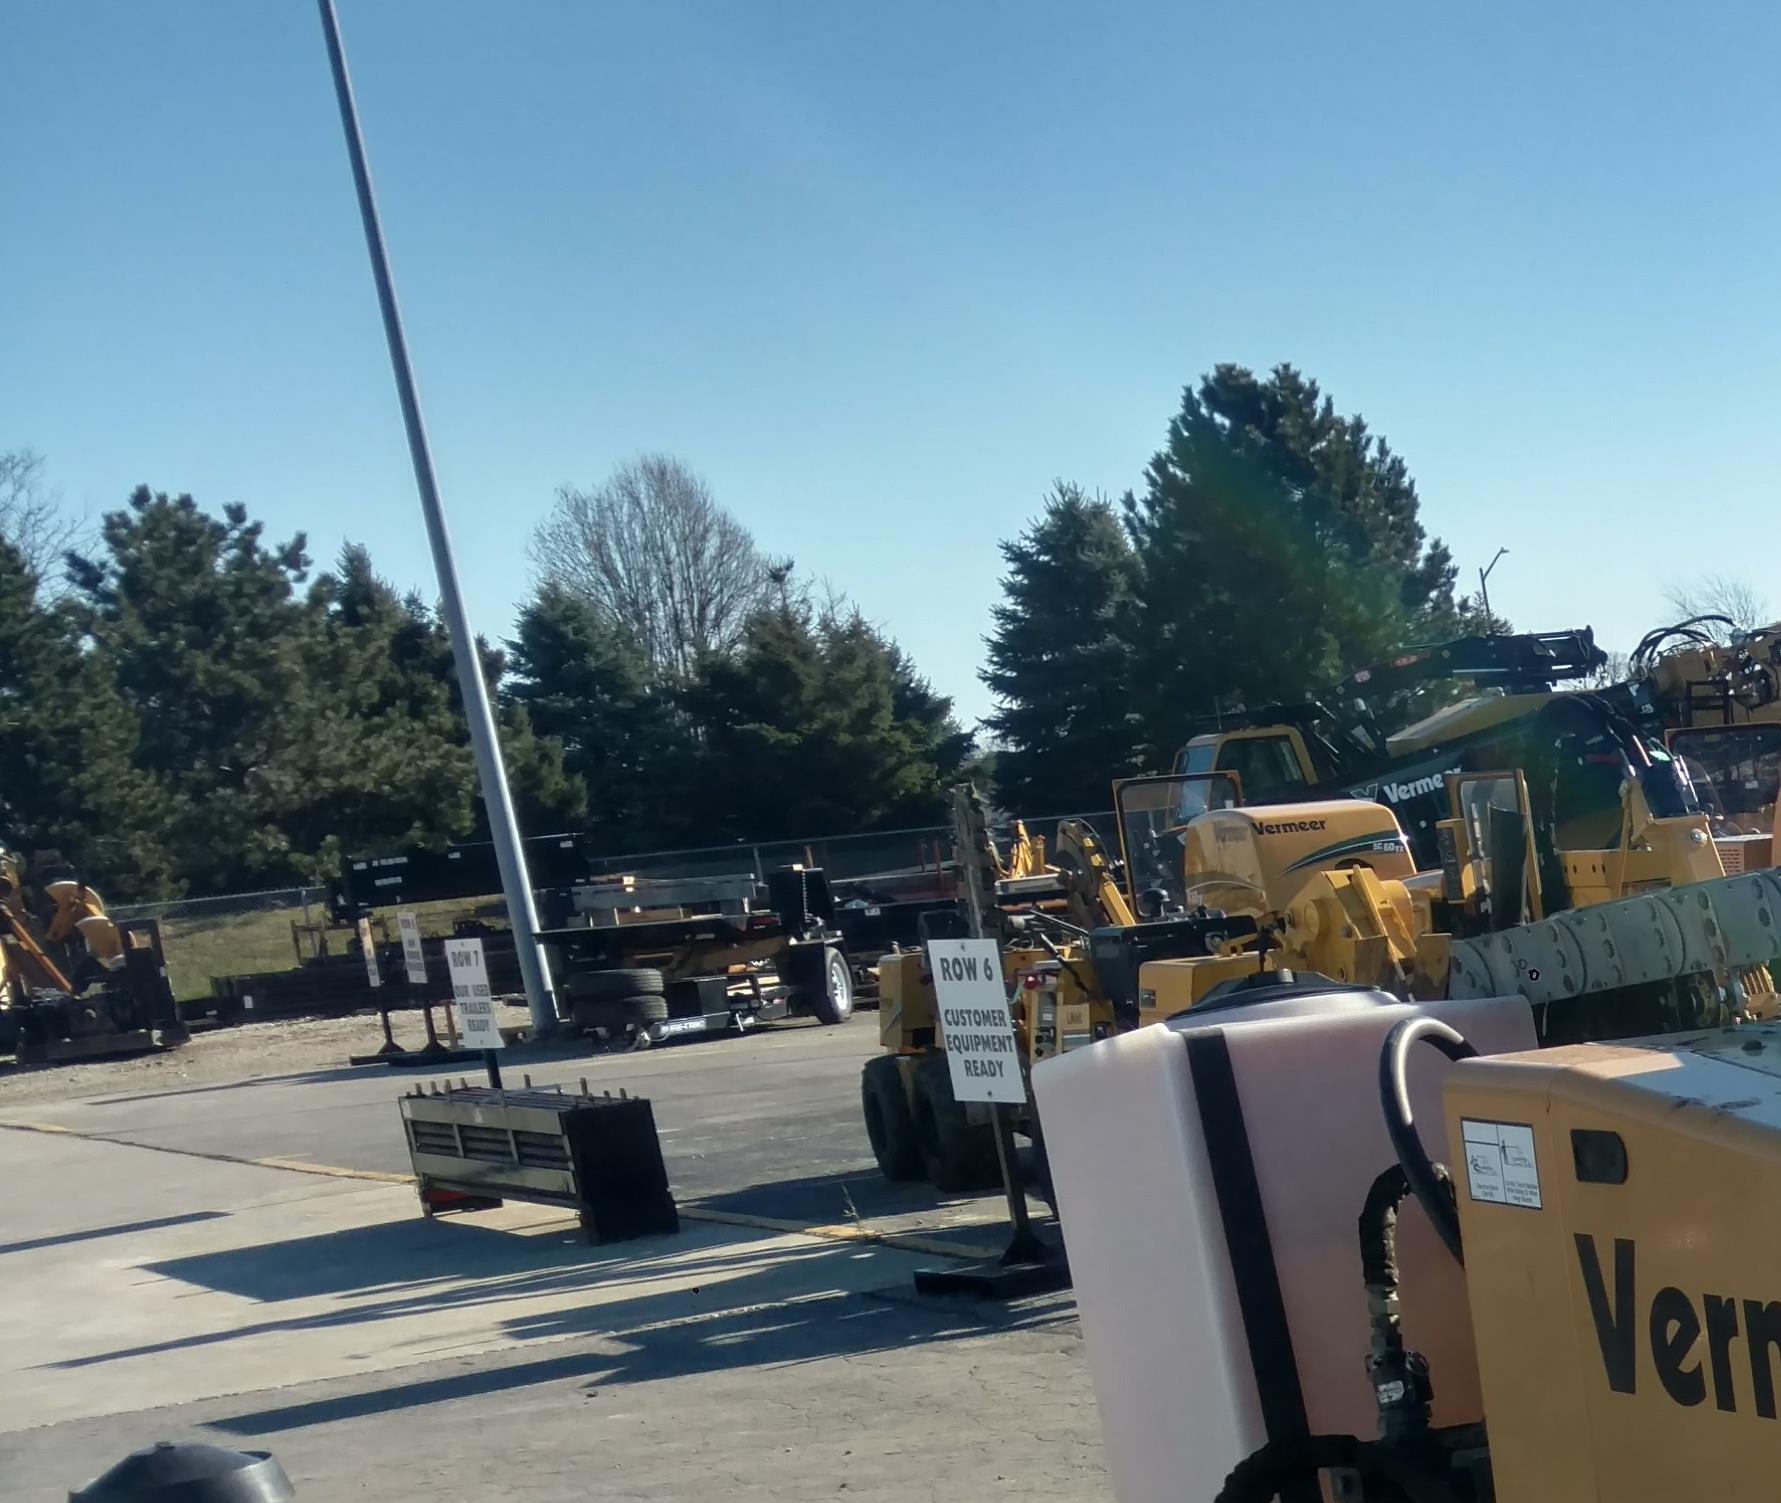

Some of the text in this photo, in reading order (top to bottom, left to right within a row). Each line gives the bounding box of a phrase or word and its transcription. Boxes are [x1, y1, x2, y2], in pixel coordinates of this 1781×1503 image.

[1383, 764, 1463, 804] Verme
[1251, 819, 1328, 836] Vermeer
[451, 950, 479, 968] ROW 7
[940, 957, 993, 982] ROW 6
[944, 1009, 1007, 1028] CUSTOMER
[946, 1033, 1014, 1055] EQUIPMENT
[964, 1059, 1004, 1078] READY
